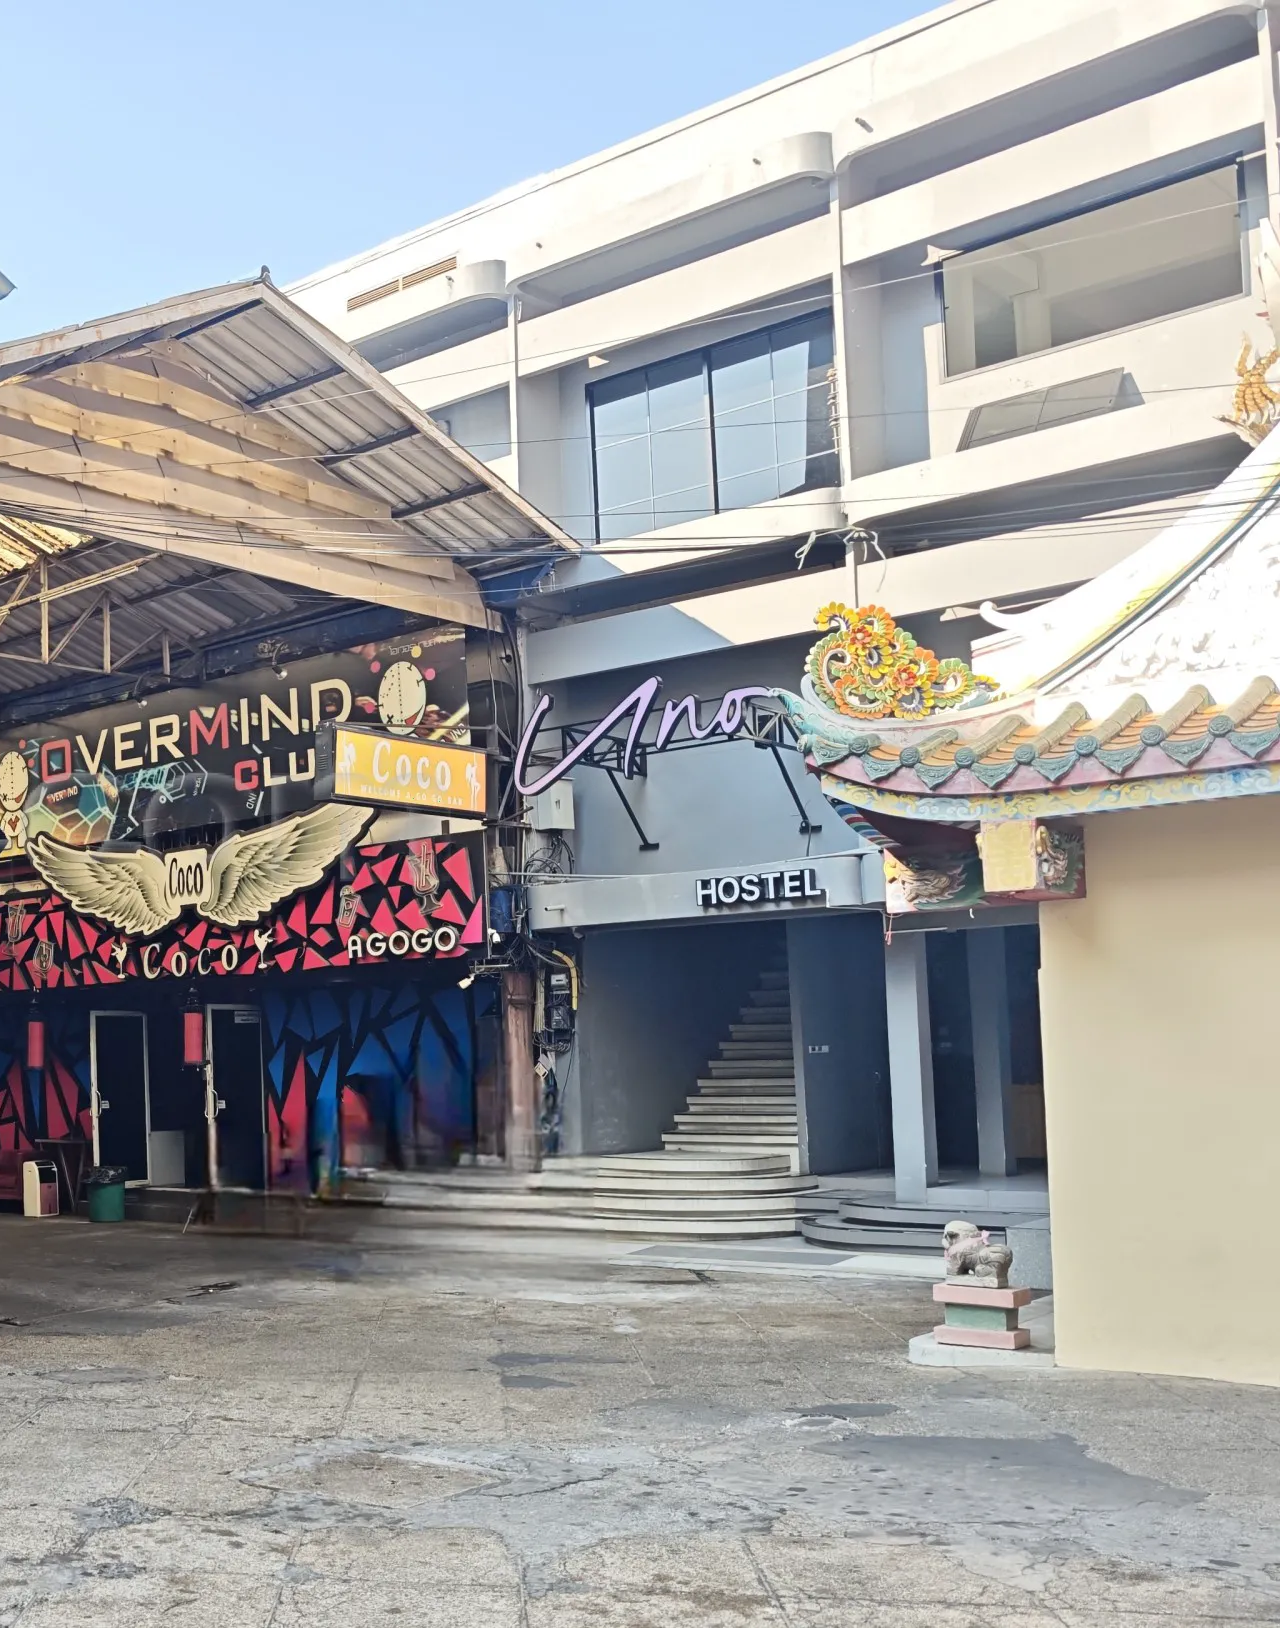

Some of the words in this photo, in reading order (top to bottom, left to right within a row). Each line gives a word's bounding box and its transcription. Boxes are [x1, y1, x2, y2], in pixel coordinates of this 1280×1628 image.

[41, 678, 353, 784] OVERMIND
[695, 869, 821, 906] HOSTEL
[347, 928, 457, 959] AGOGO
